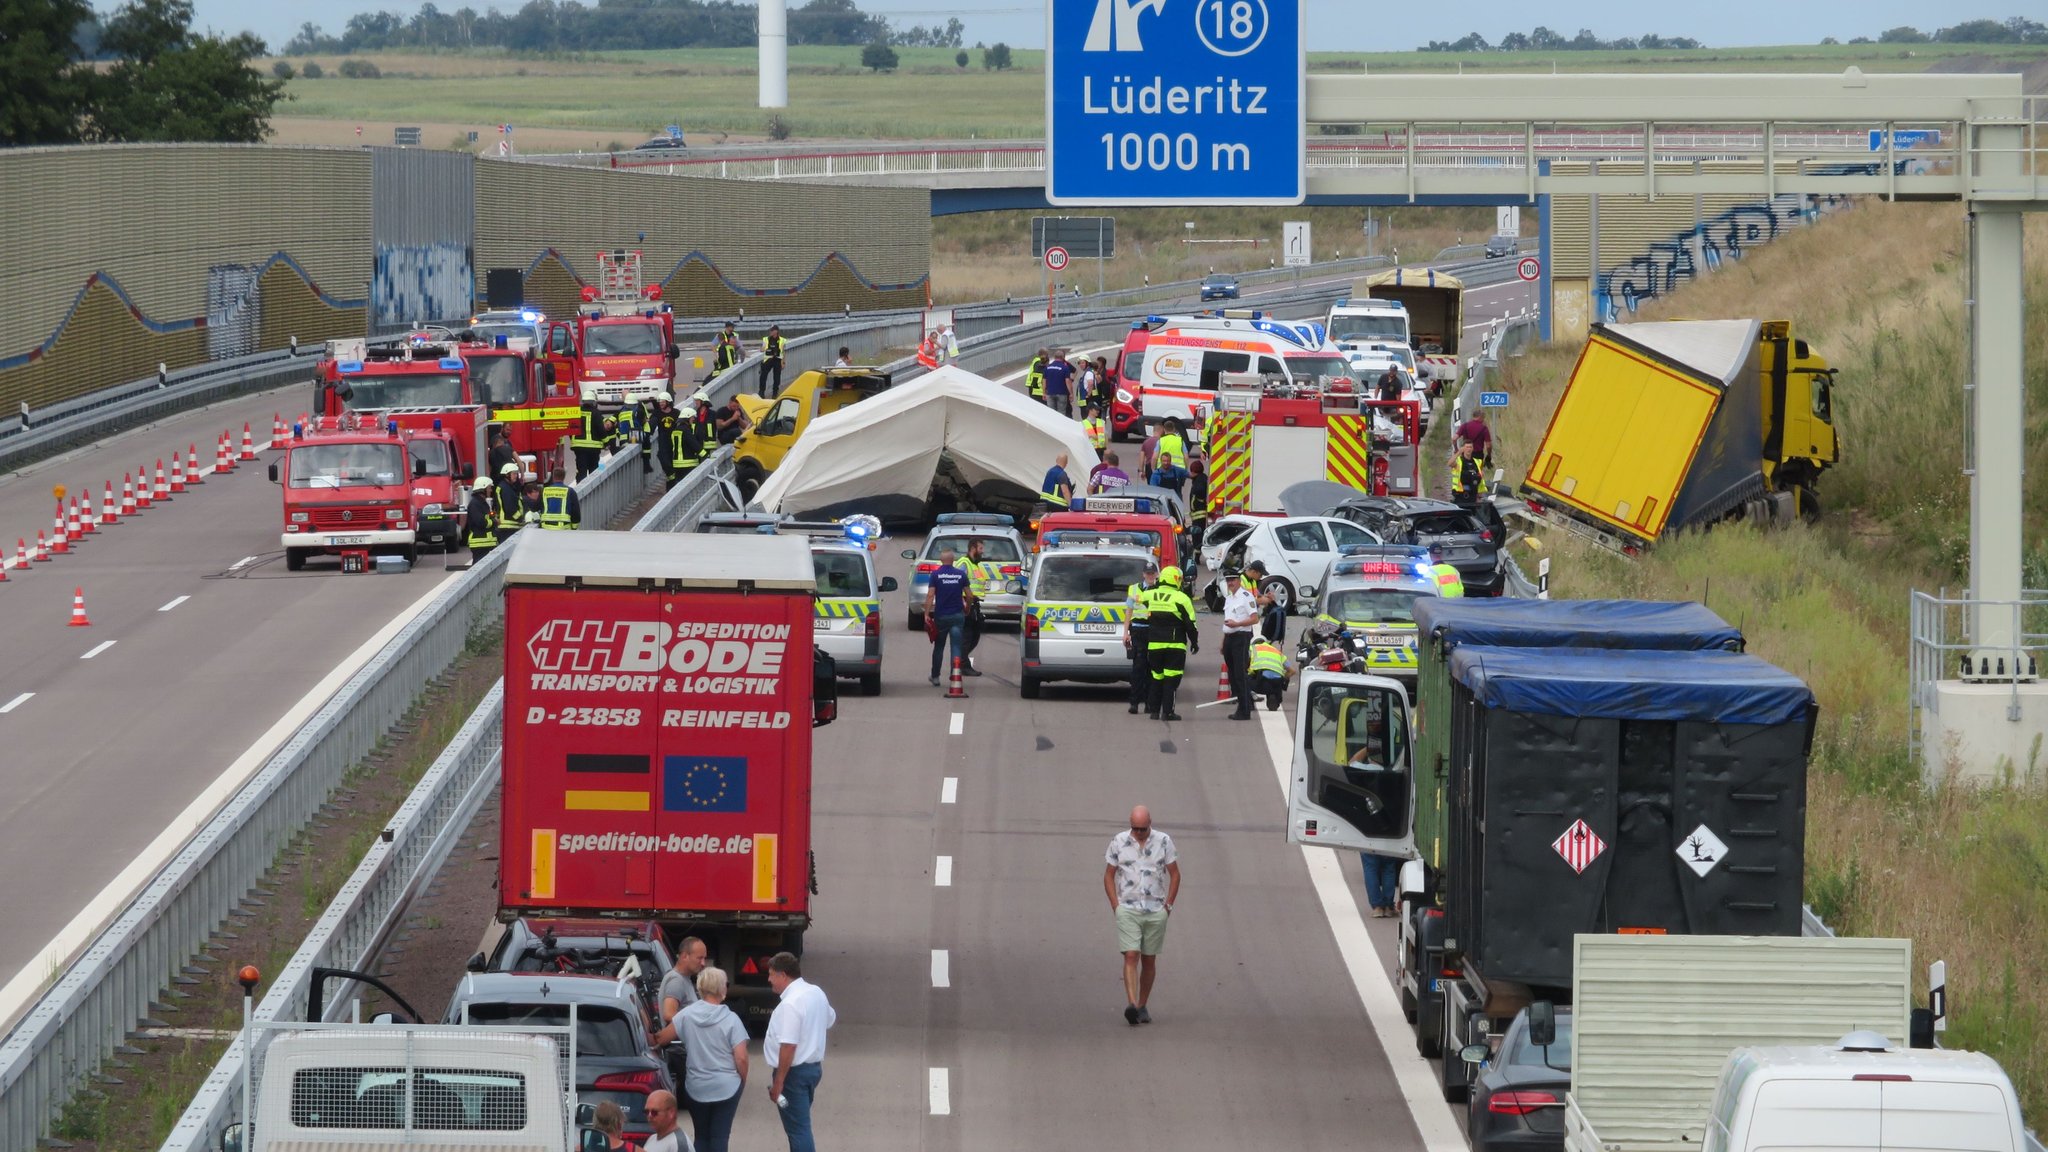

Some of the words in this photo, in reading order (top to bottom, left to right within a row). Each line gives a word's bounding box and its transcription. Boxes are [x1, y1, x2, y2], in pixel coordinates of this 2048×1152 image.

[1210, 0, 1253, 39] 18
[1083, 75, 1268, 115] Lüderitz
[1101, 132, 1199, 171] 1000
[1212, 142, 1250, 171] m
[1050, 253, 1064, 265] 100
[1522, 263, 1538, 275] 100
[1166, 336, 1223, 349] RETTUNGSDIENST
[1087, 501, 1132, 510] FEUERWEHR
[1364, 562, 1400, 574] UNFALL
[1044, 610, 1080, 618] POLIZEI
[676, 621, 791, 641] SPEDITION
[619, 621, 787, 675] BODE
[530, 673, 661, 693] TRANSPORT
[662, 679, 678, 694] &
[682, 676, 780, 696] LOGISTIK
[559, 707, 642, 727] 23858
[662, 709, 791, 730] REINFELD
[558, 831, 753, 854] spedition-bode.de
